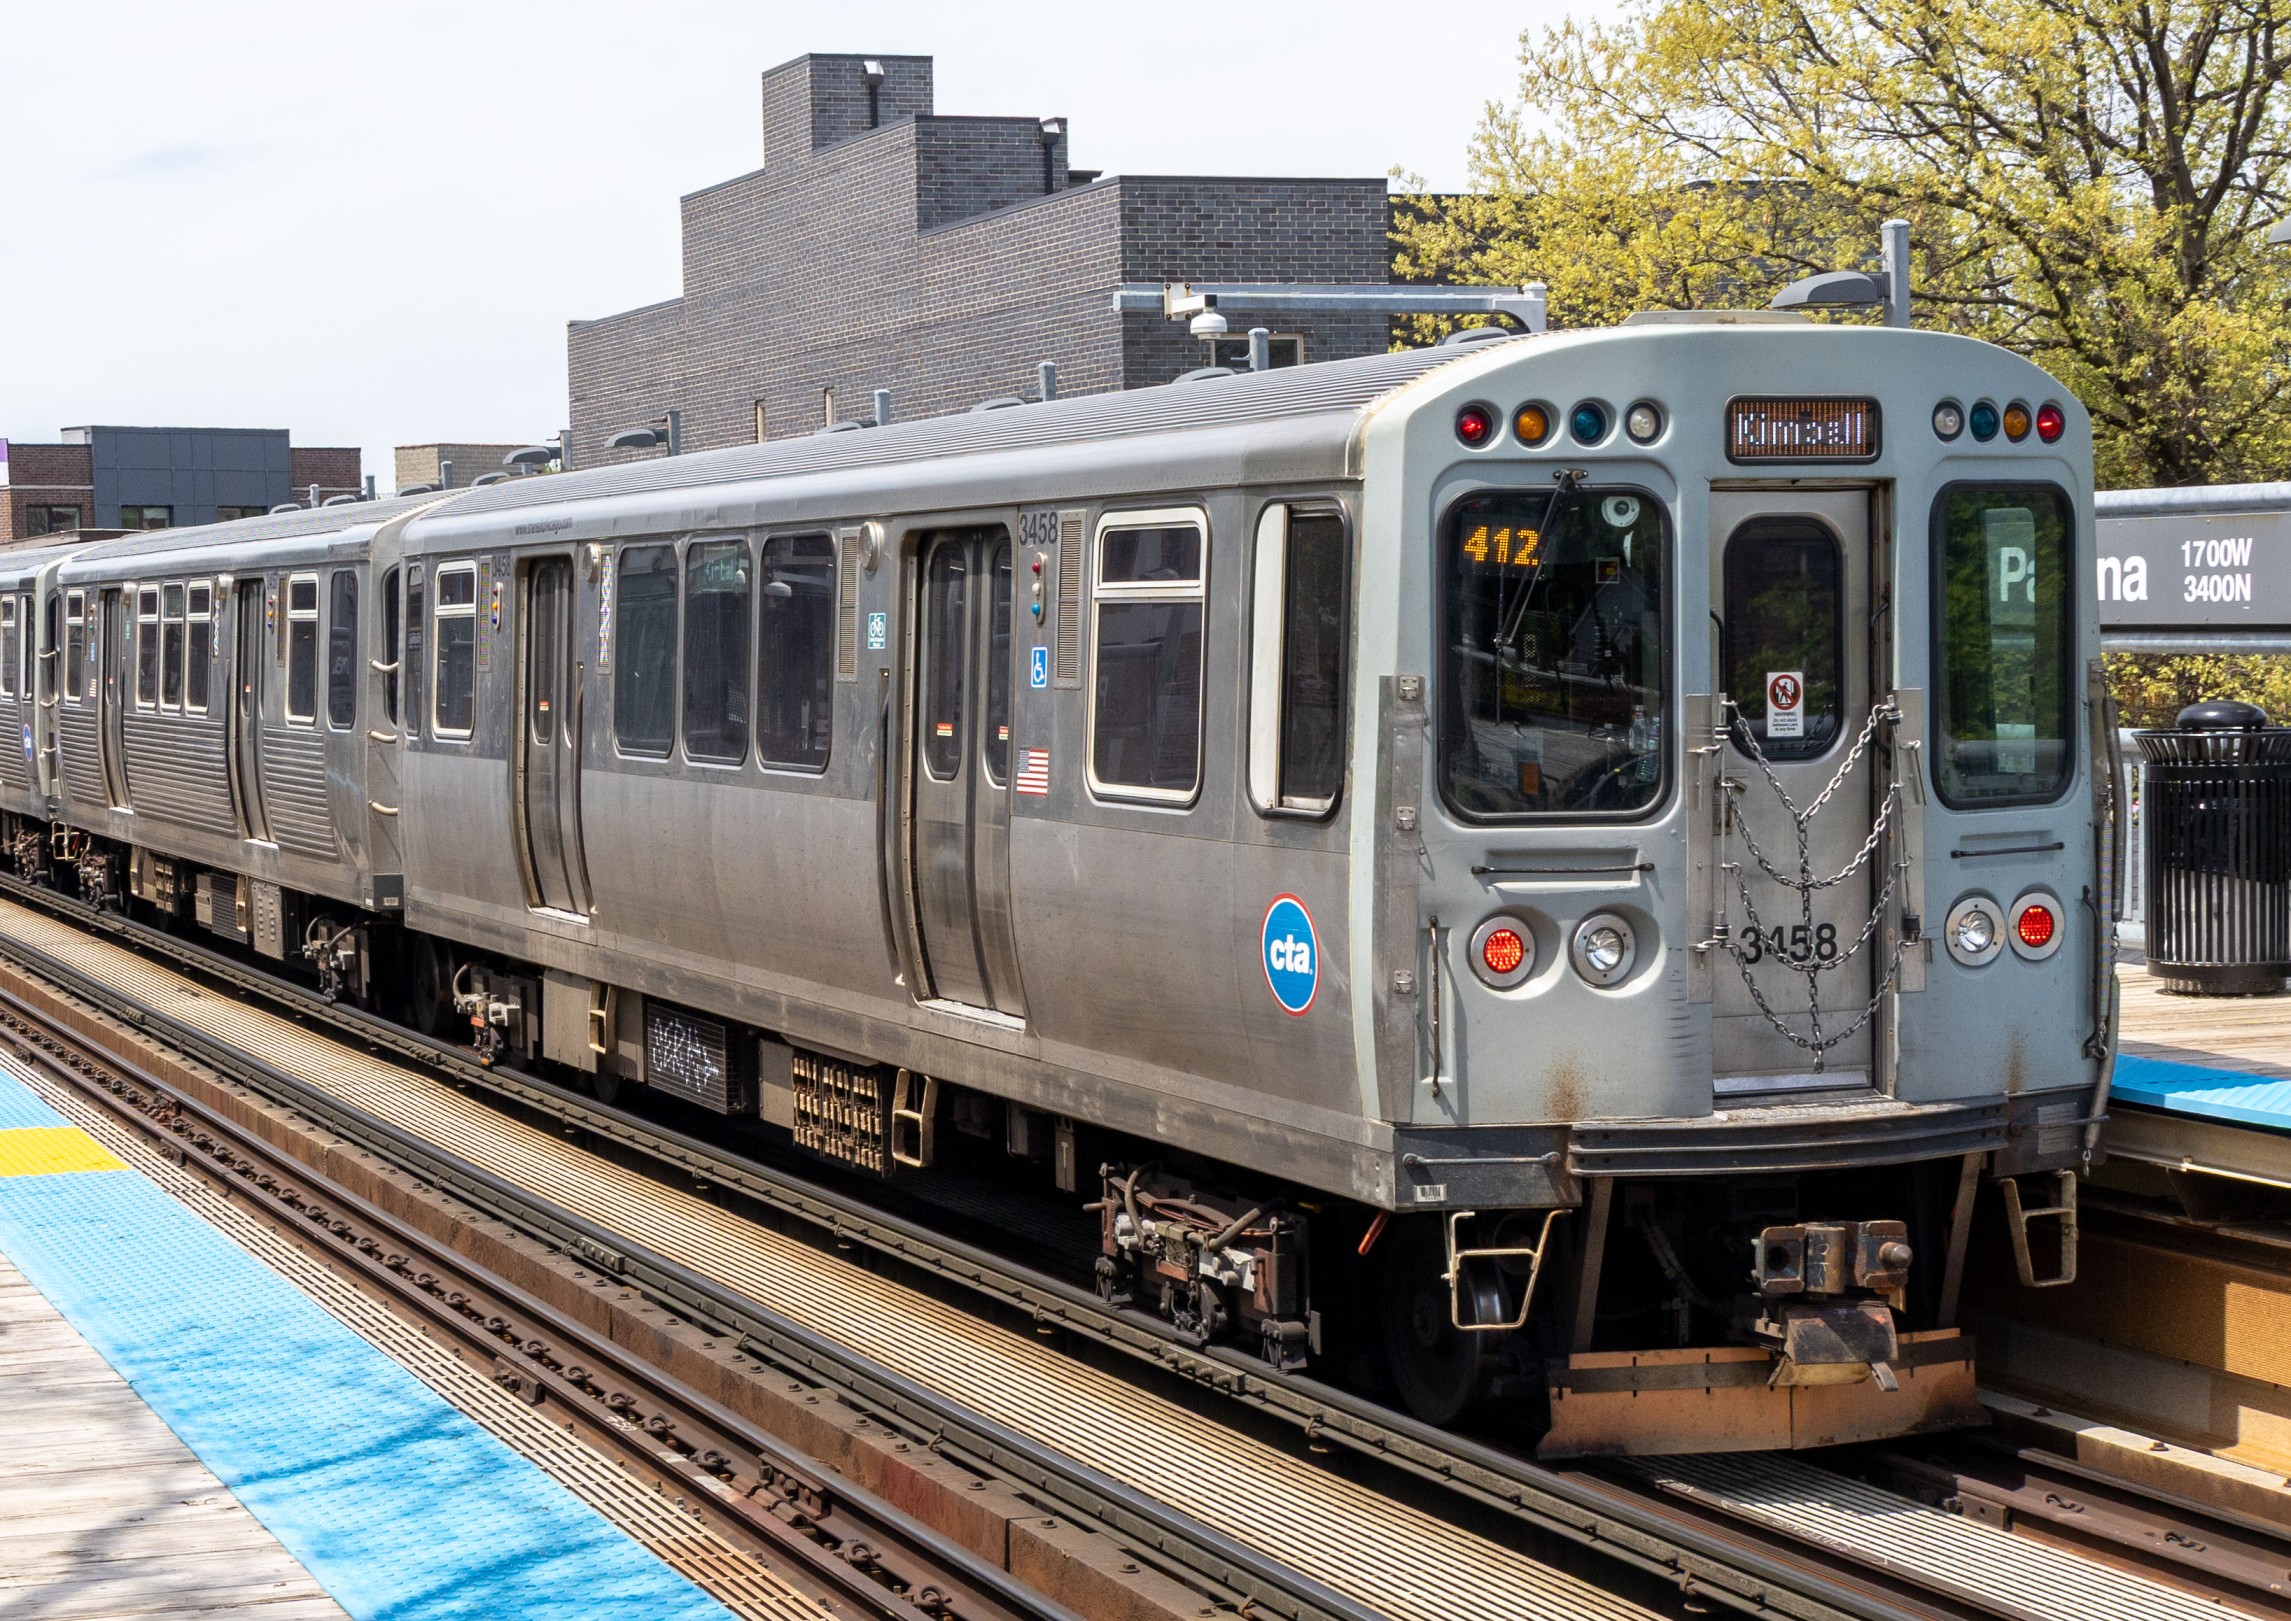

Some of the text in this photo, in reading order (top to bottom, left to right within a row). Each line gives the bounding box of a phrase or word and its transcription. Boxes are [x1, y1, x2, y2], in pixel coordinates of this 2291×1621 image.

[1019, 511, 1058, 546] 3458
[1464, 526, 1539, 566] 412
[492, 554, 511, 577] 3458
[2181, 537, 2253, 568] 1700W
[2183, 573, 2251, 602] 3400N
[1270, 934, 1310, 975] cta
[1740, 922, 1838, 965] 3458
